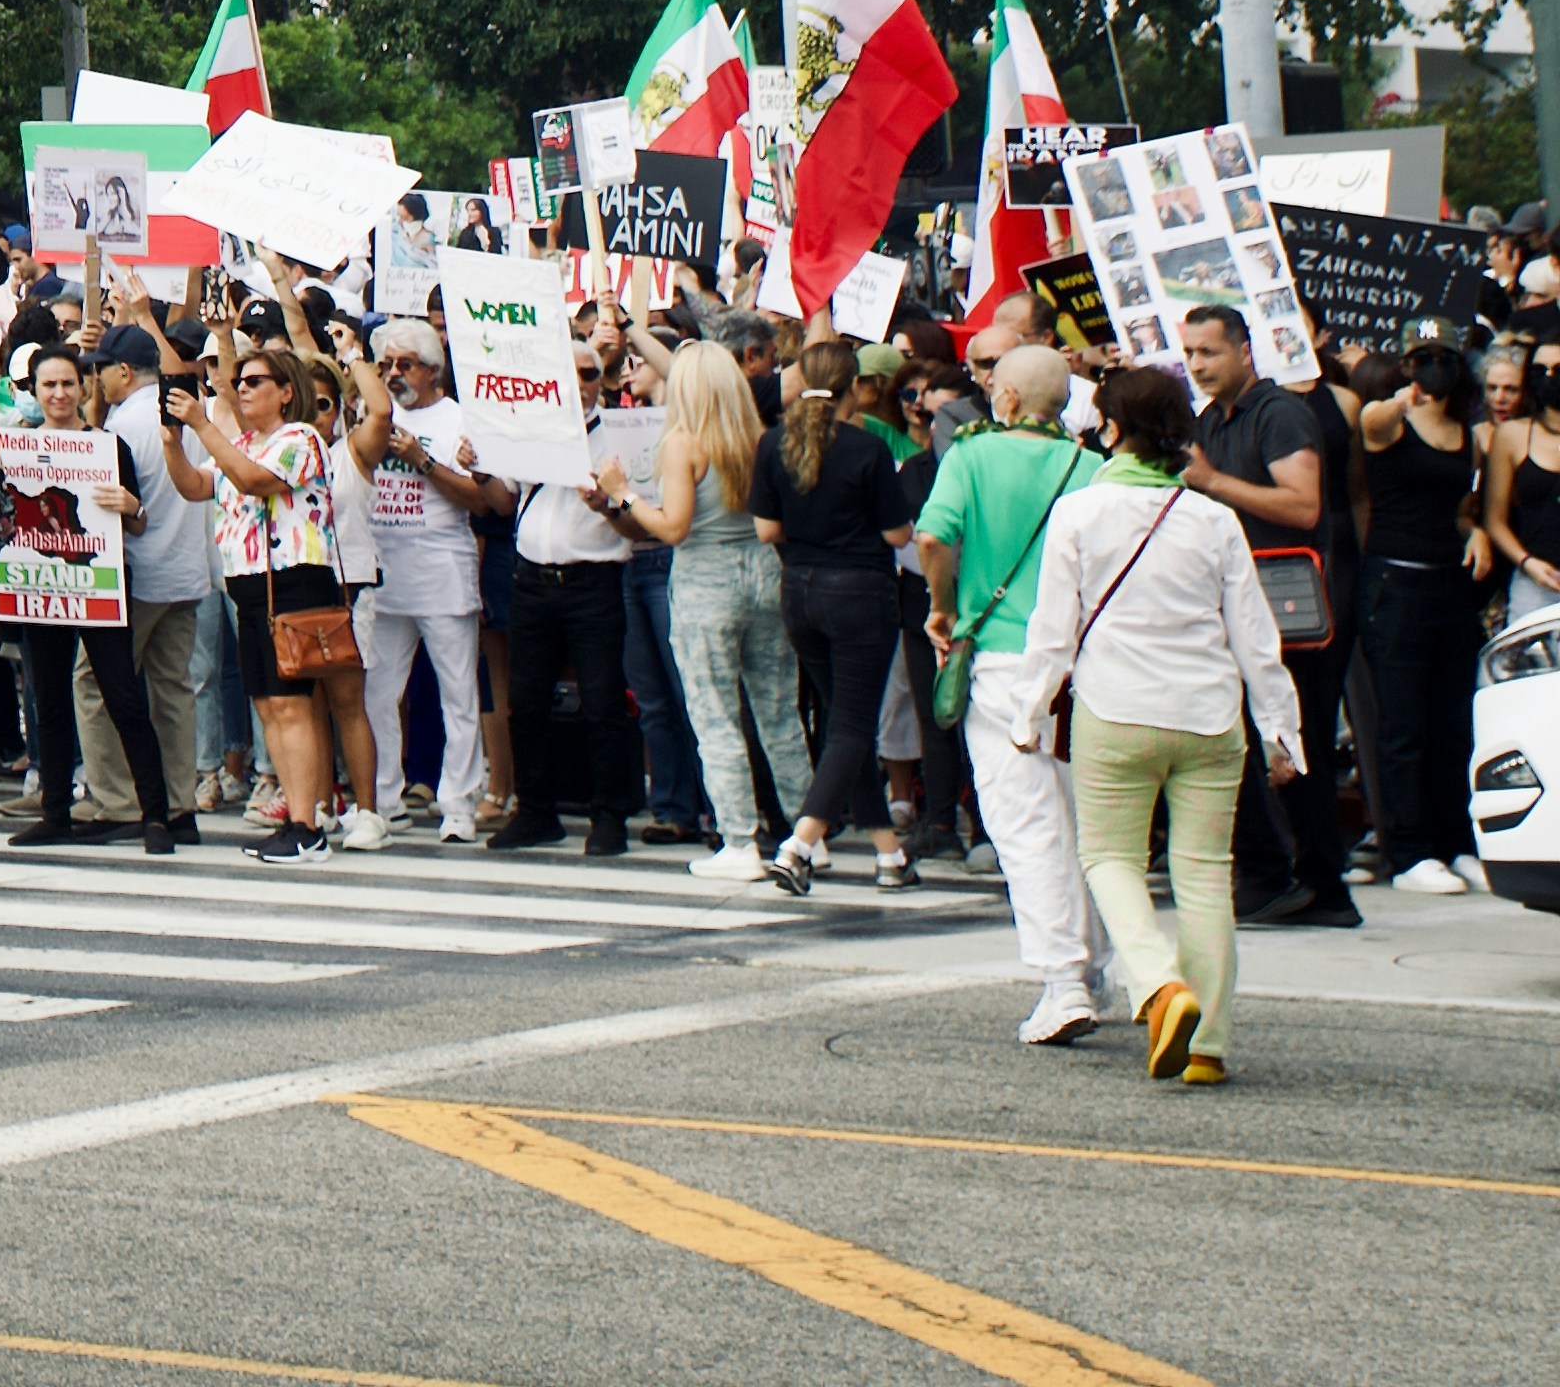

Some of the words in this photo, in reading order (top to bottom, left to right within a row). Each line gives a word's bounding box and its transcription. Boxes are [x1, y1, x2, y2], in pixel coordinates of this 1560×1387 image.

[1021, 127, 1108, 145] HEAR
[608, 216, 705, 259] AMINI
[1297, 248, 1407, 282] ZAHEDAN
[464, 298, 537, 327] WOMEN
[474, 373, 562, 407] FREEDOM
[43, 436, 94, 454] Silence
[4, 465, 43, 483] porting
[47, 465, 113, 484] Oppressor
[399, 479, 425, 491] THE
[12, 526, 106, 554] MahsaAmini
[7, 564, 95, 588] STAND
[15, 595, 87, 619] IRAN
